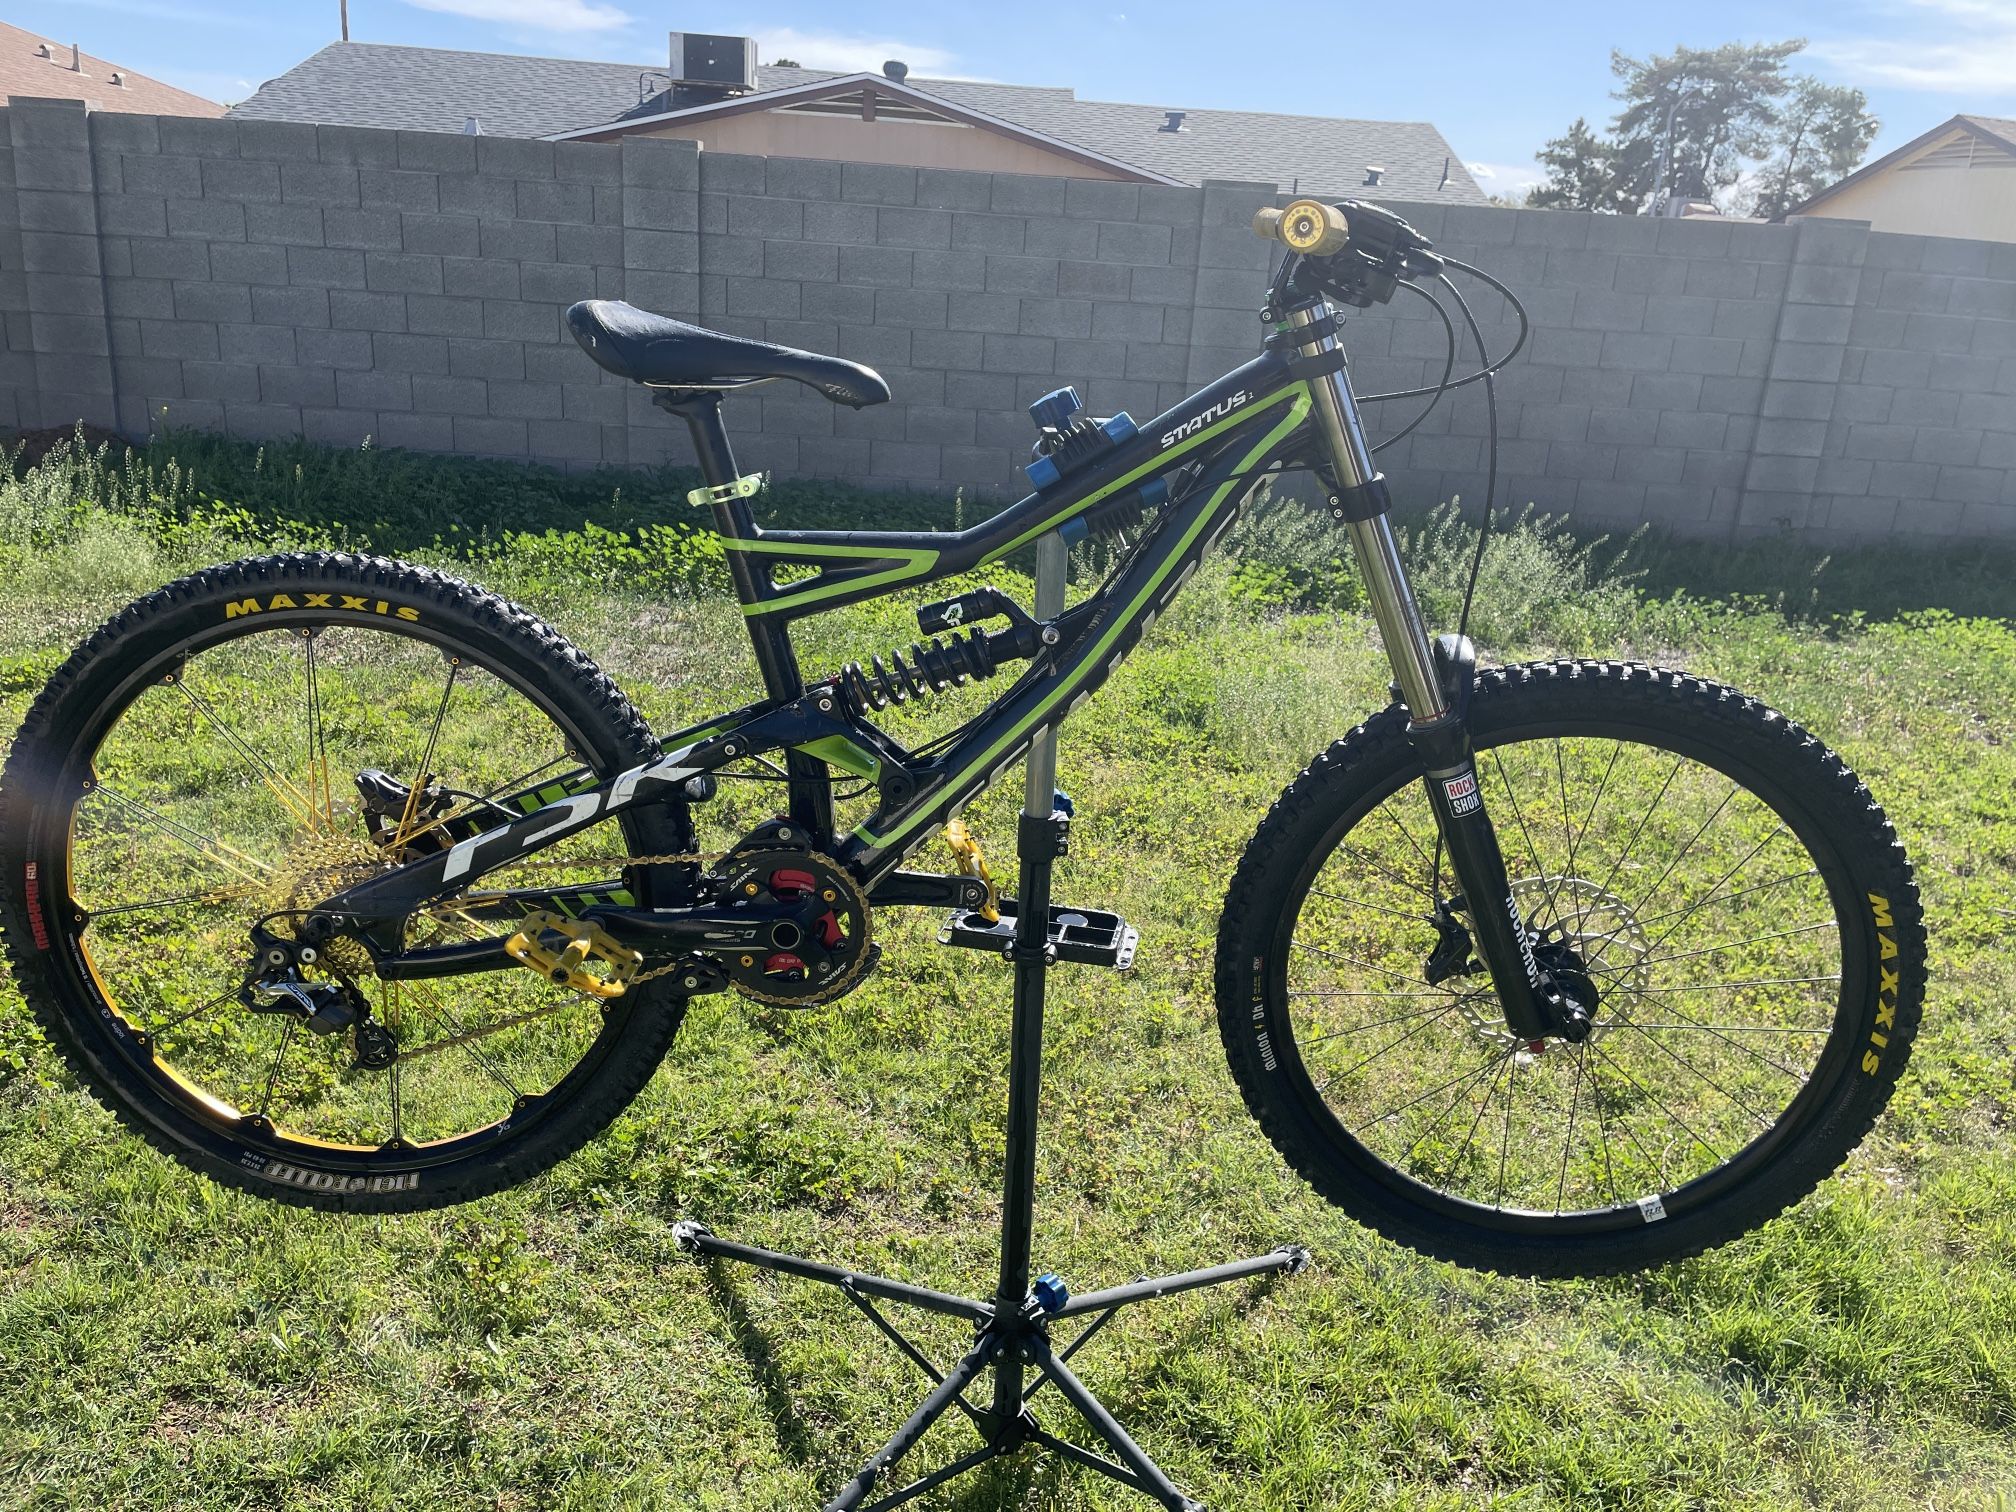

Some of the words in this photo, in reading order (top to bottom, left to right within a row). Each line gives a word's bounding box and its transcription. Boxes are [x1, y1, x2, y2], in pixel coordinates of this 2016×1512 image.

[1161, 390, 1246, 448] STATUS
[225, 593, 420, 621] MAXXIS
[1448, 777, 1475, 798] ROCK
[1862, 892, 1898, 1077] MAXXIS
[263, 1159, 350, 1192] ROLLER
[366, 1171, 420, 1193] HIGH
